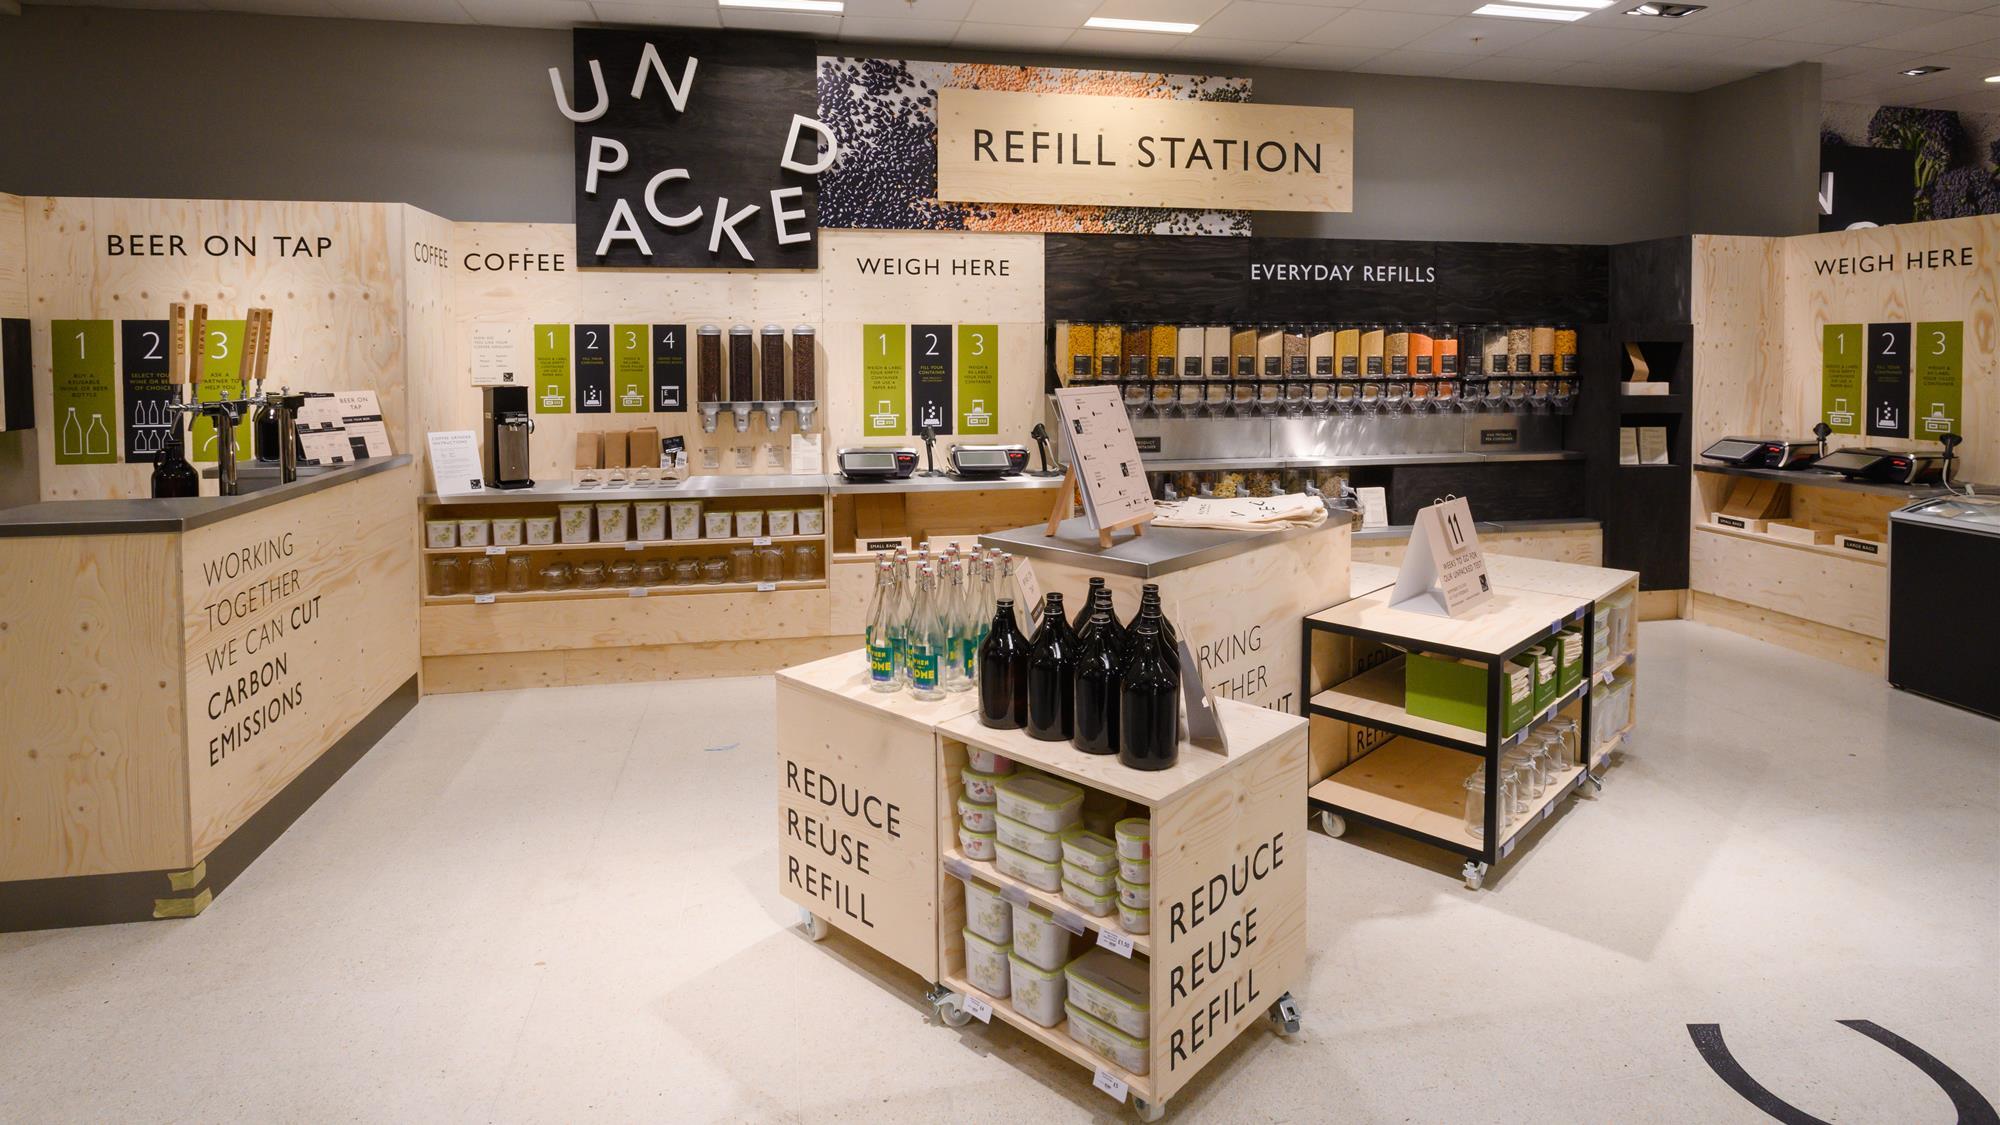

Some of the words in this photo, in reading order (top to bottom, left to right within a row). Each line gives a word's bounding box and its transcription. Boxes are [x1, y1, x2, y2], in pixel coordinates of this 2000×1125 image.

[973, 129, 1116, 167] REFILL
[1137, 136, 1321, 174] STATION
[107, 234, 188, 257] BEER
[204, 235, 256, 257] ON
[273, 236, 333, 258] TAP
[414, 242, 448, 269] COFFEE
[464, 253, 565, 272] COFFEE
[857, 258, 939, 276] WEIGH
[952, 259, 1010, 277] HERE
[1251, 263, 1355, 282] EVERYDAY
[1364, 265, 1435, 283] REFILLS
[1814, 254, 1893, 276] WEIGH
[1907, 247, 1973, 270] HERE
[75, 331, 85, 360] 1
[142, 331, 163, 360] 2
[211, 331, 228, 360] 3
[547, 331, 554, 349] 1
[586, 331, 599, 349] 2
[626, 331, 637, 349] 3
[662, 331, 675, 349] 4
[879, 333, 887, 356] 1
[925, 333, 940, 356] 2
[971, 333, 984, 356] 3
[1837, 332, 1844, 355] 1
[1881, 331, 1897, 355] 2
[1931, 331, 1946, 356] 3
[1447, 512, 1464, 545] 11
[203, 532, 294, 587] WORKING
[204, 569, 300, 632] TOGETHER
[205, 638, 237, 676] WE
[246, 614, 284, 655] CAN
[290, 595, 322, 631] CUT
[1200, 625, 1261, 670] RKING
[871, 662, 891, 671] OME
[914, 669, 935, 679] OME
[207, 652, 288, 720] CARBON
[1212, 665, 1268, 700] THER
[209, 681, 303, 767] EMISSIONS
[787, 760, 901, 838] REDUCE
[788, 807, 870, 875] REUSE
[788, 855, 874, 928] REFILL
[1170, 831, 1284, 944] REDUCE
[1170, 907, 1257, 1007] REUSE
[1170, 968, 1260, 1072] REFILL
